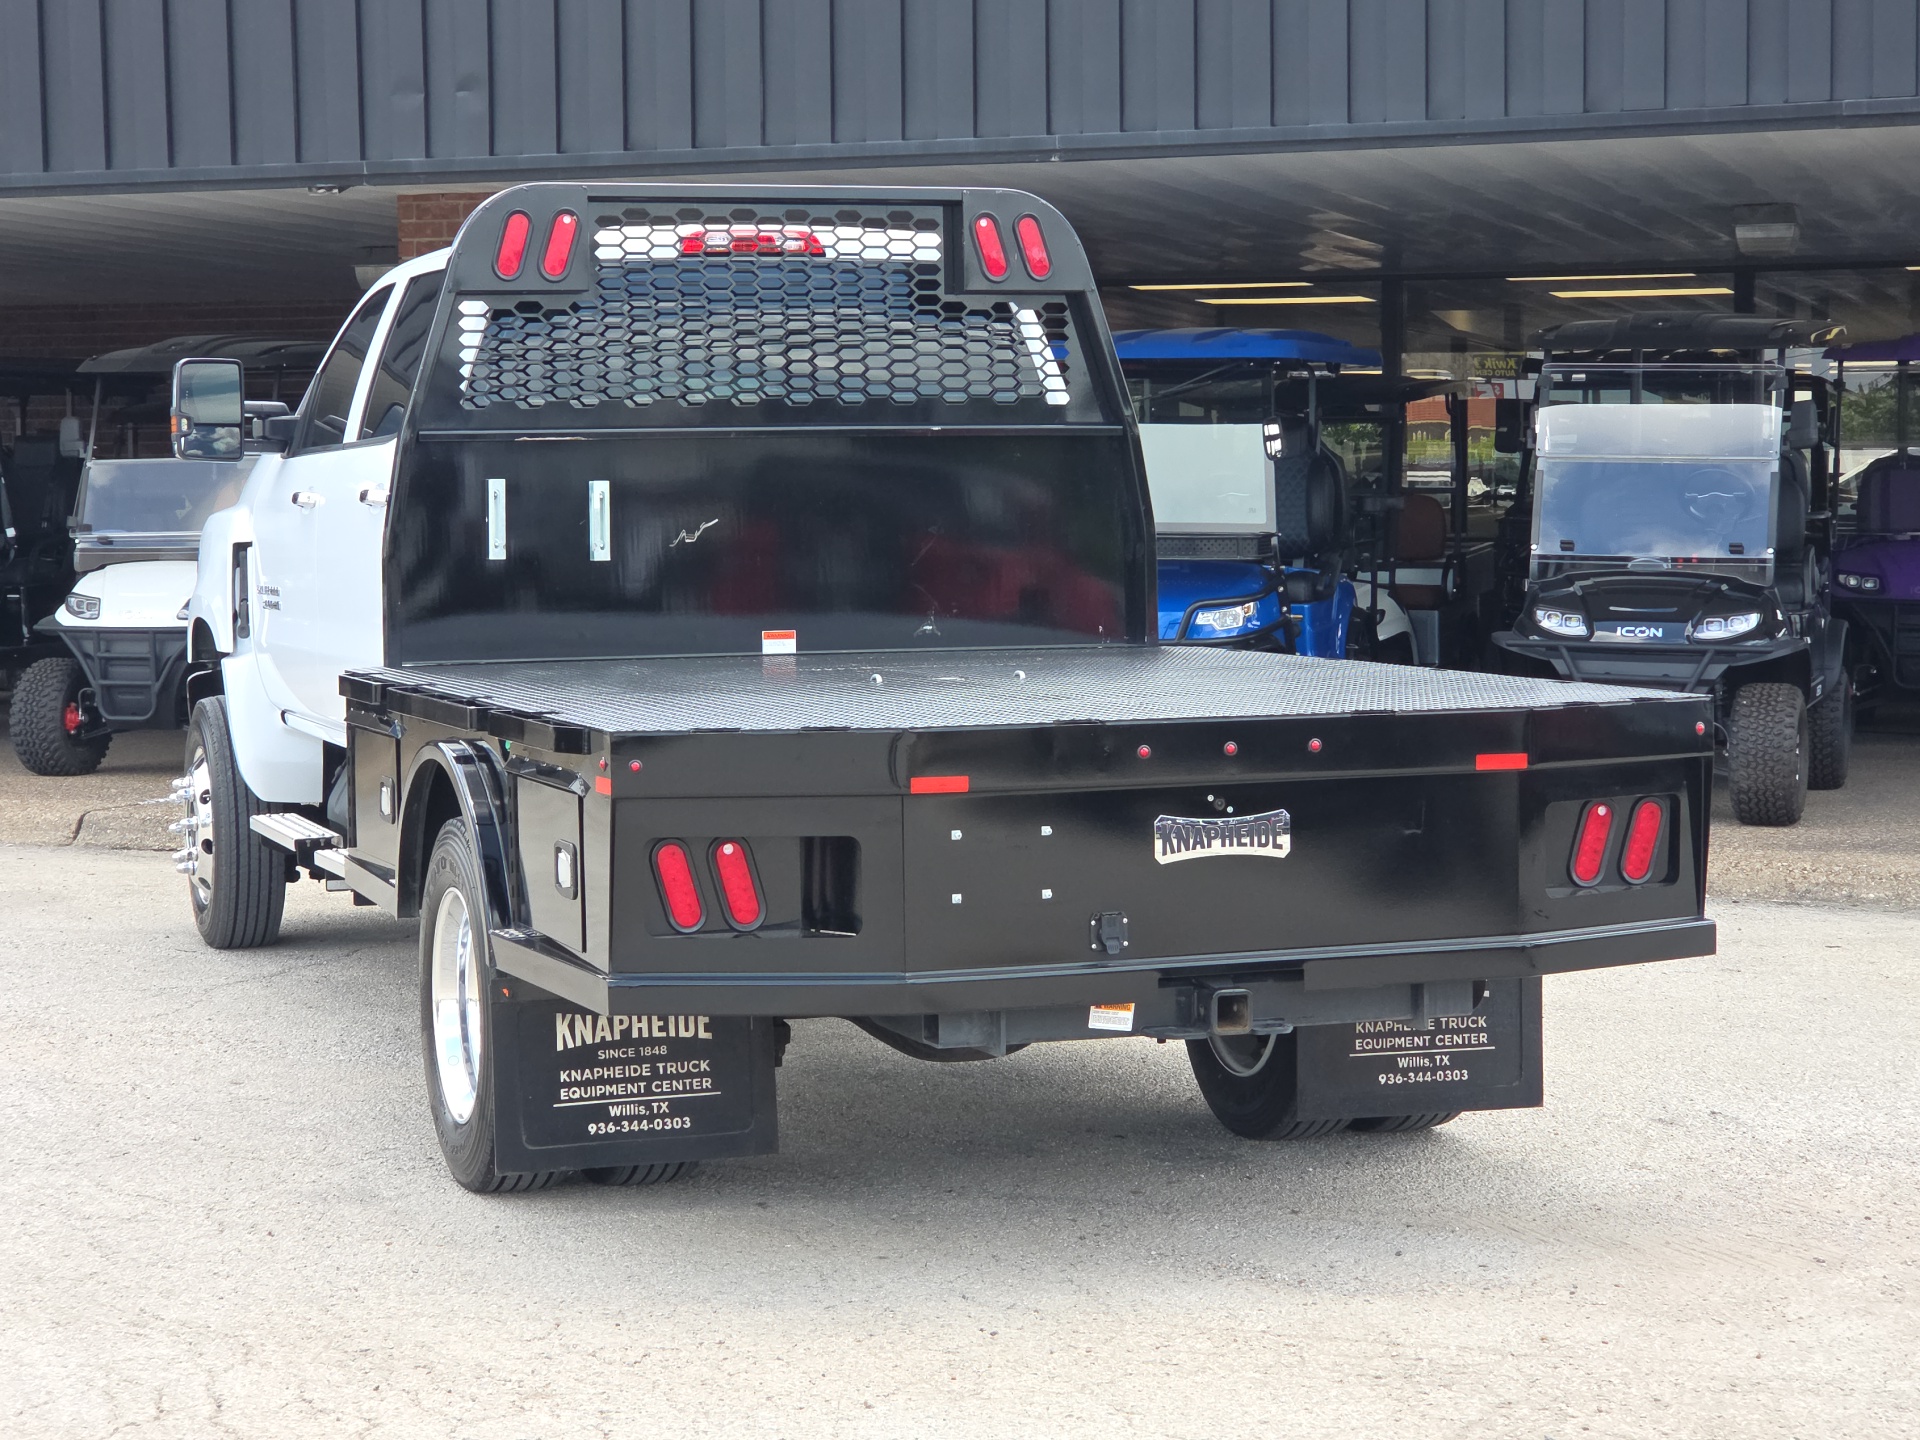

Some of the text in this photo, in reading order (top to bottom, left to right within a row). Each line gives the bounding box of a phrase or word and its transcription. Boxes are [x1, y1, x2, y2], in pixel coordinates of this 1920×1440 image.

[1616, 626, 1663, 638] ICON
[1160, 820, 1284, 856] KNAPHEIDE
[1440, 1016, 1487, 1030] TRUCK
[1355, 1032, 1488, 1051] EQUIPMENT CENTER
[597, 1045, 668, 1060] SINCE 1848
[1397, 1054, 1450, 1068] Willis, TX
[560, 1059, 711, 1083] KNAPHEIDE TRUCK
[1378, 1069, 1469, 1085] 936-344-0303
[560, 1077, 712, 1101] EQUIPMENT CENTER
[608, 1101, 670, 1117] Willis, TX
[587, 1116, 692, 1136] 936-344-0303
